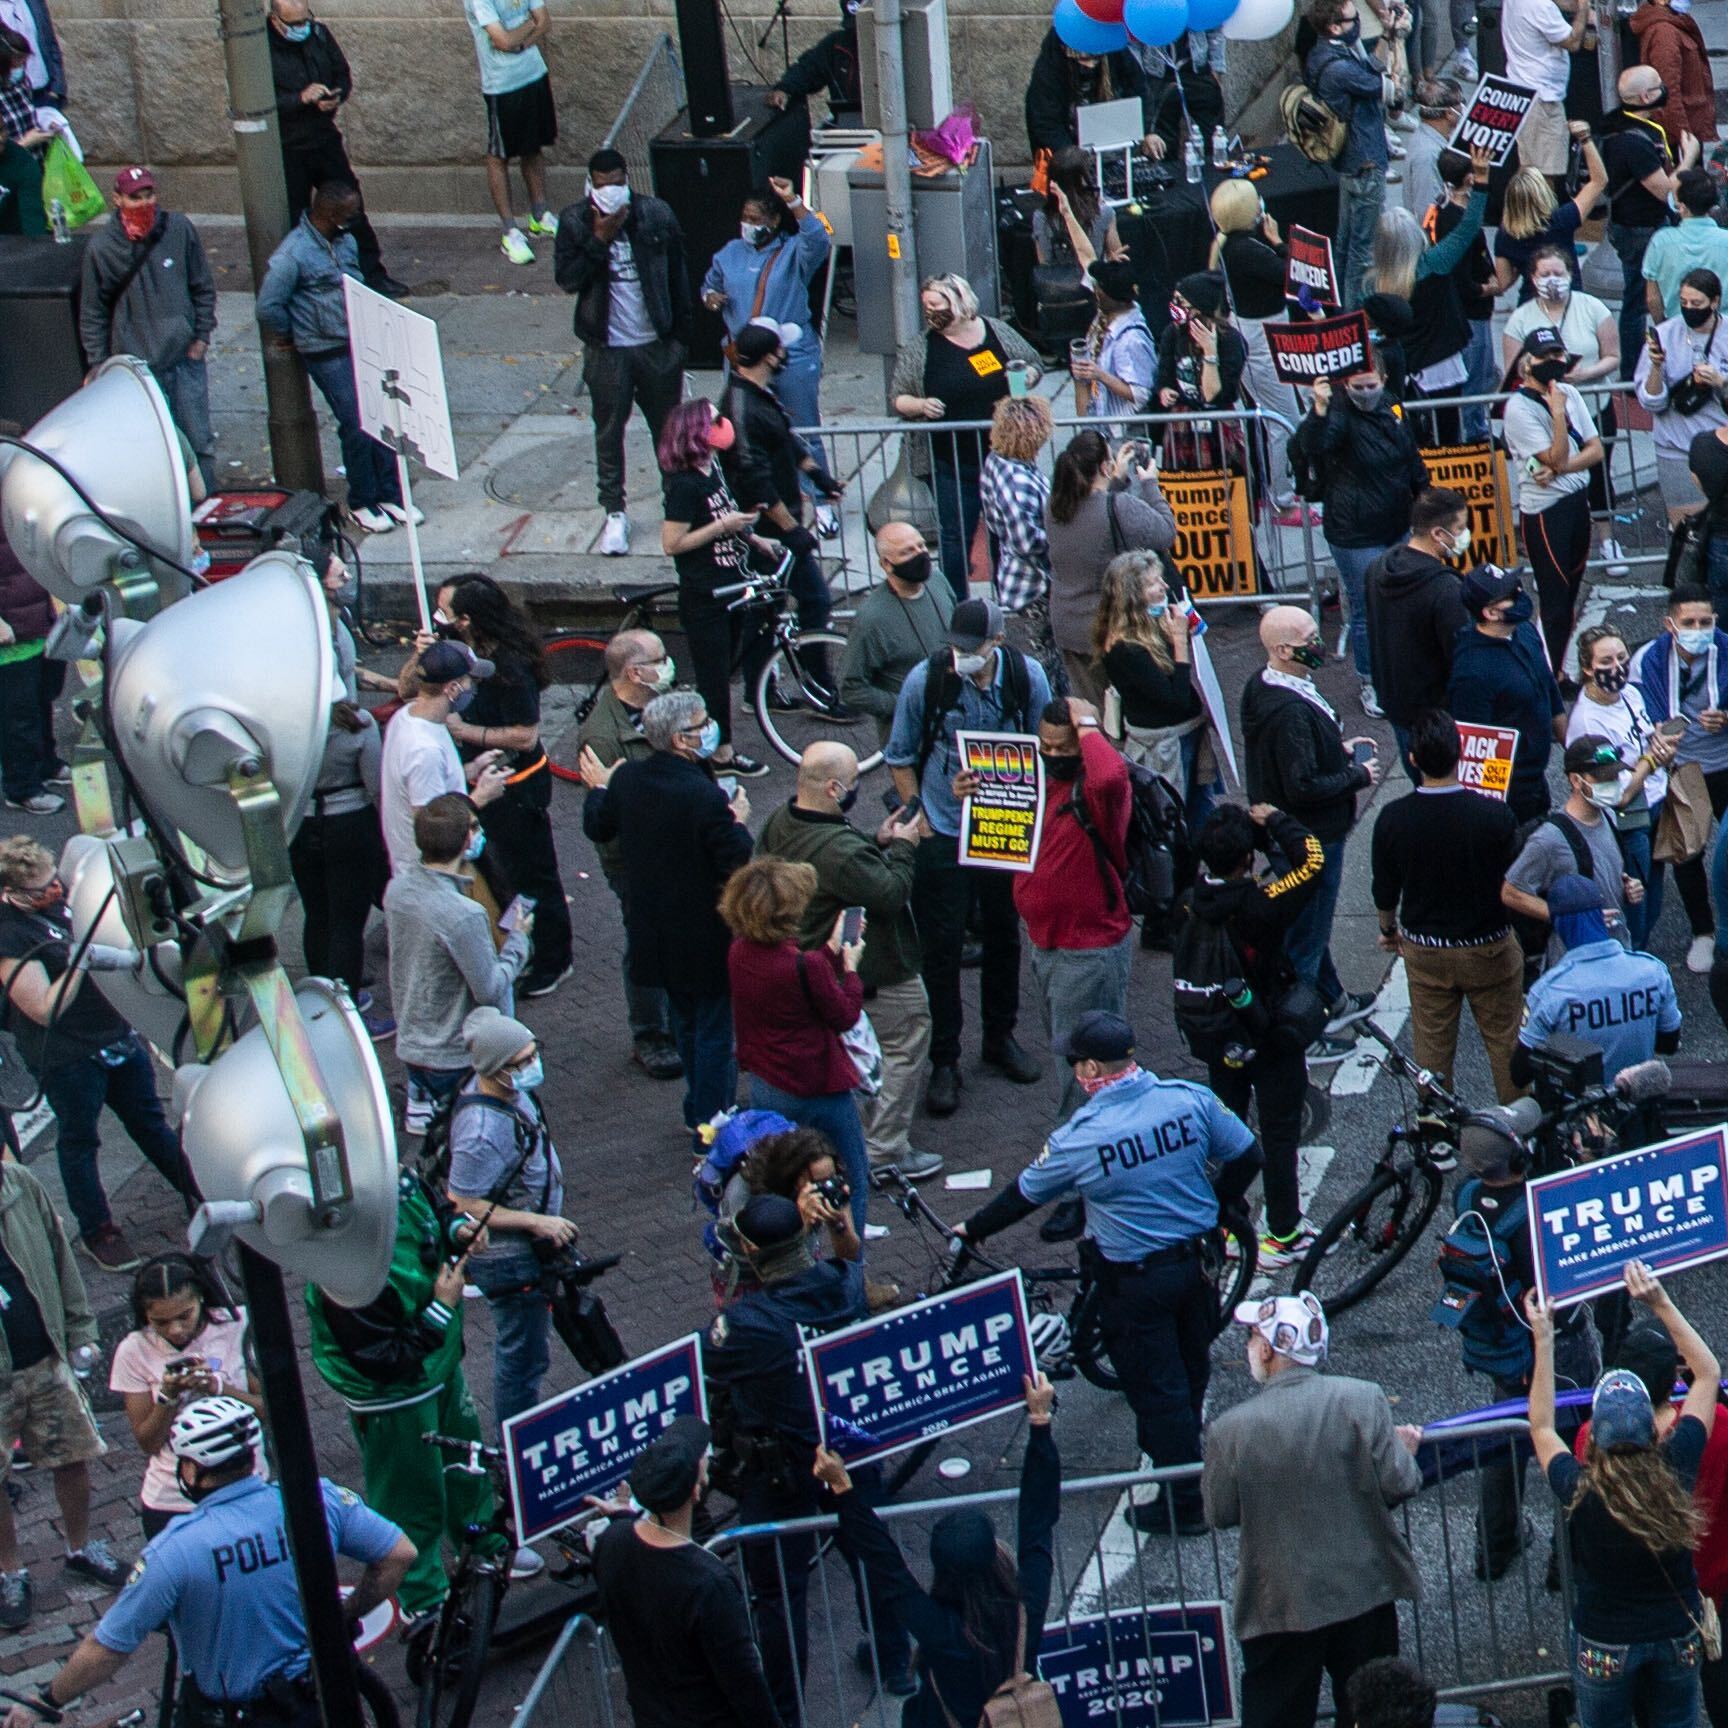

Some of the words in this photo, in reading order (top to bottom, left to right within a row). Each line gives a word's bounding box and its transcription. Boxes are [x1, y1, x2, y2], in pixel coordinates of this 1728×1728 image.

[1479, 85, 1531, 113] COUNT
[1462, 122, 1513, 152] VOTE
[1272, 333, 1318, 354] TRUMP
[1320, 324, 1359, 348] MUST
[1278, 342, 1364, 374] CONCEDE
[967, 741, 1035, 786] NO!
[1486, 764, 1507, 774] OUT
[969, 834, 1009, 851] MUST
[1010, 838, 1029, 854] GO!
[979, 822, 1029, 838] REGIME
[1568, 988, 1659, 1037] POLICE
[1095, 1115, 1201, 1180] POLICE
[1543, 1162, 1720, 1240] TRUMP
[1562, 1190, 1711, 1254] PENCE
[1556, 1251, 1587, 1269] MAKE
[1587, 1236, 1638, 1260] AMERICA
[1639, 1224, 1673, 1245] GREAT
[1674, 1212, 1719, 1234] AGAIN!
[827, 1313, 1015, 1400] TRUMP
[850, 1343, 1003, 1413] PENCE
[880, 1393, 931, 1418] AMERICA
[932, 1378, 970, 1400] GREAT
[970, 1362, 1015, 1386] AGAIN!
[522, 1375, 689, 1471] TRUMP
[541, 1412, 659, 1486] PENCE
[1052, 1648, 1193, 1680] TRUMP
[1085, 1681, 1163, 1714] 2020
